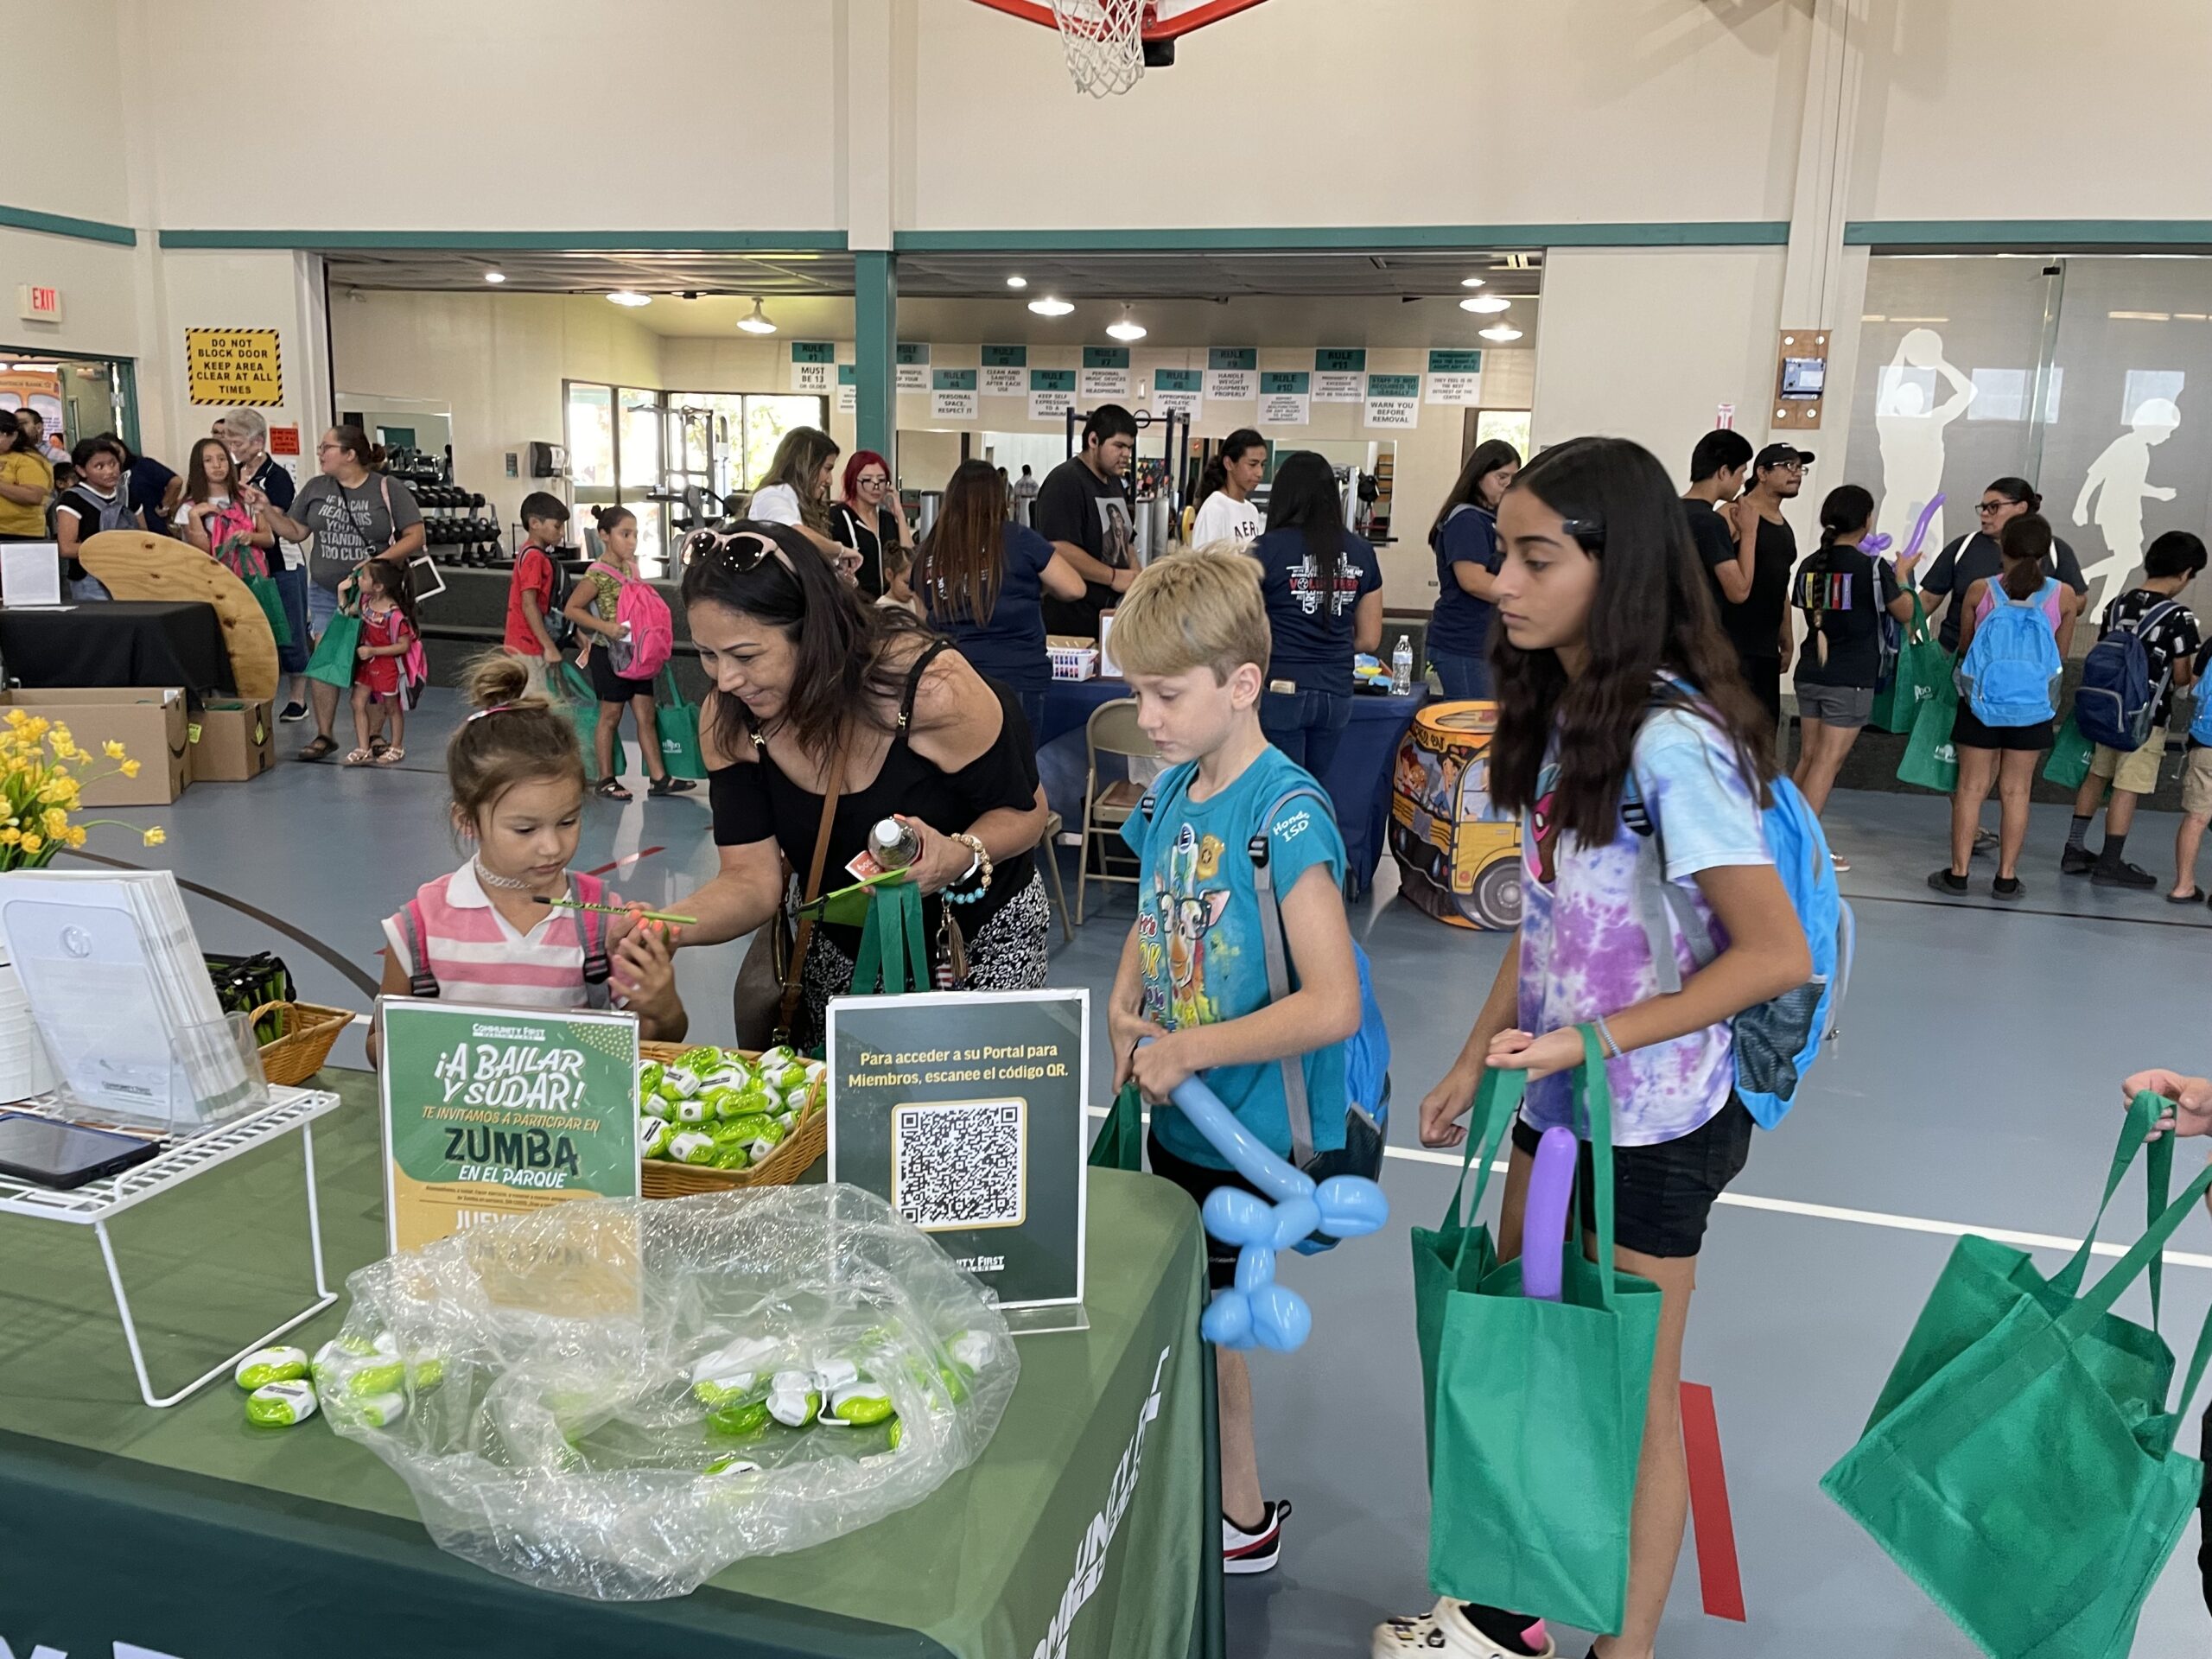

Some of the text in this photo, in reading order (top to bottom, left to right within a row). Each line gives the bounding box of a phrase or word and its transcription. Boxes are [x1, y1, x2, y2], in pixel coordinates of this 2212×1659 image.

[33, 288, 55, 312] EXIT
[212, 339, 252, 347] DO NOT
[198, 349, 232, 358] BLOCK
[204, 362, 264, 371] KEEP AREA
[801, 366, 824, 375] MUST
[197, 372, 230, 380] CLEAR
[1166, 372, 1190, 380] RULE
[219, 385, 251, 394] TIMES
[327, 494, 369, 512] IF CAN
[318, 505, 350, 523] READ
[1235, 521, 1258, 538] AER
[321, 544, 338, 560] TOO
[1282, 820, 1309, 842] ISD
[435, 1042, 585, 1081] ¡A BAILAR
[861, 1046, 1058, 1066] Para acceder a su Portal para
[849, 1063, 1069, 1088] Miembros, escanee el código QR.
[442, 1072, 586, 1111] Y SUDAR!
[423, 1106, 601, 1133] TE INVITAMOS A PARTICIPAR EN
[444, 1125, 579, 1177] ZUMBA
[458, 1165, 567, 1189] EN EL PARQUE
[978, 1256, 1005, 1267] FIRST
